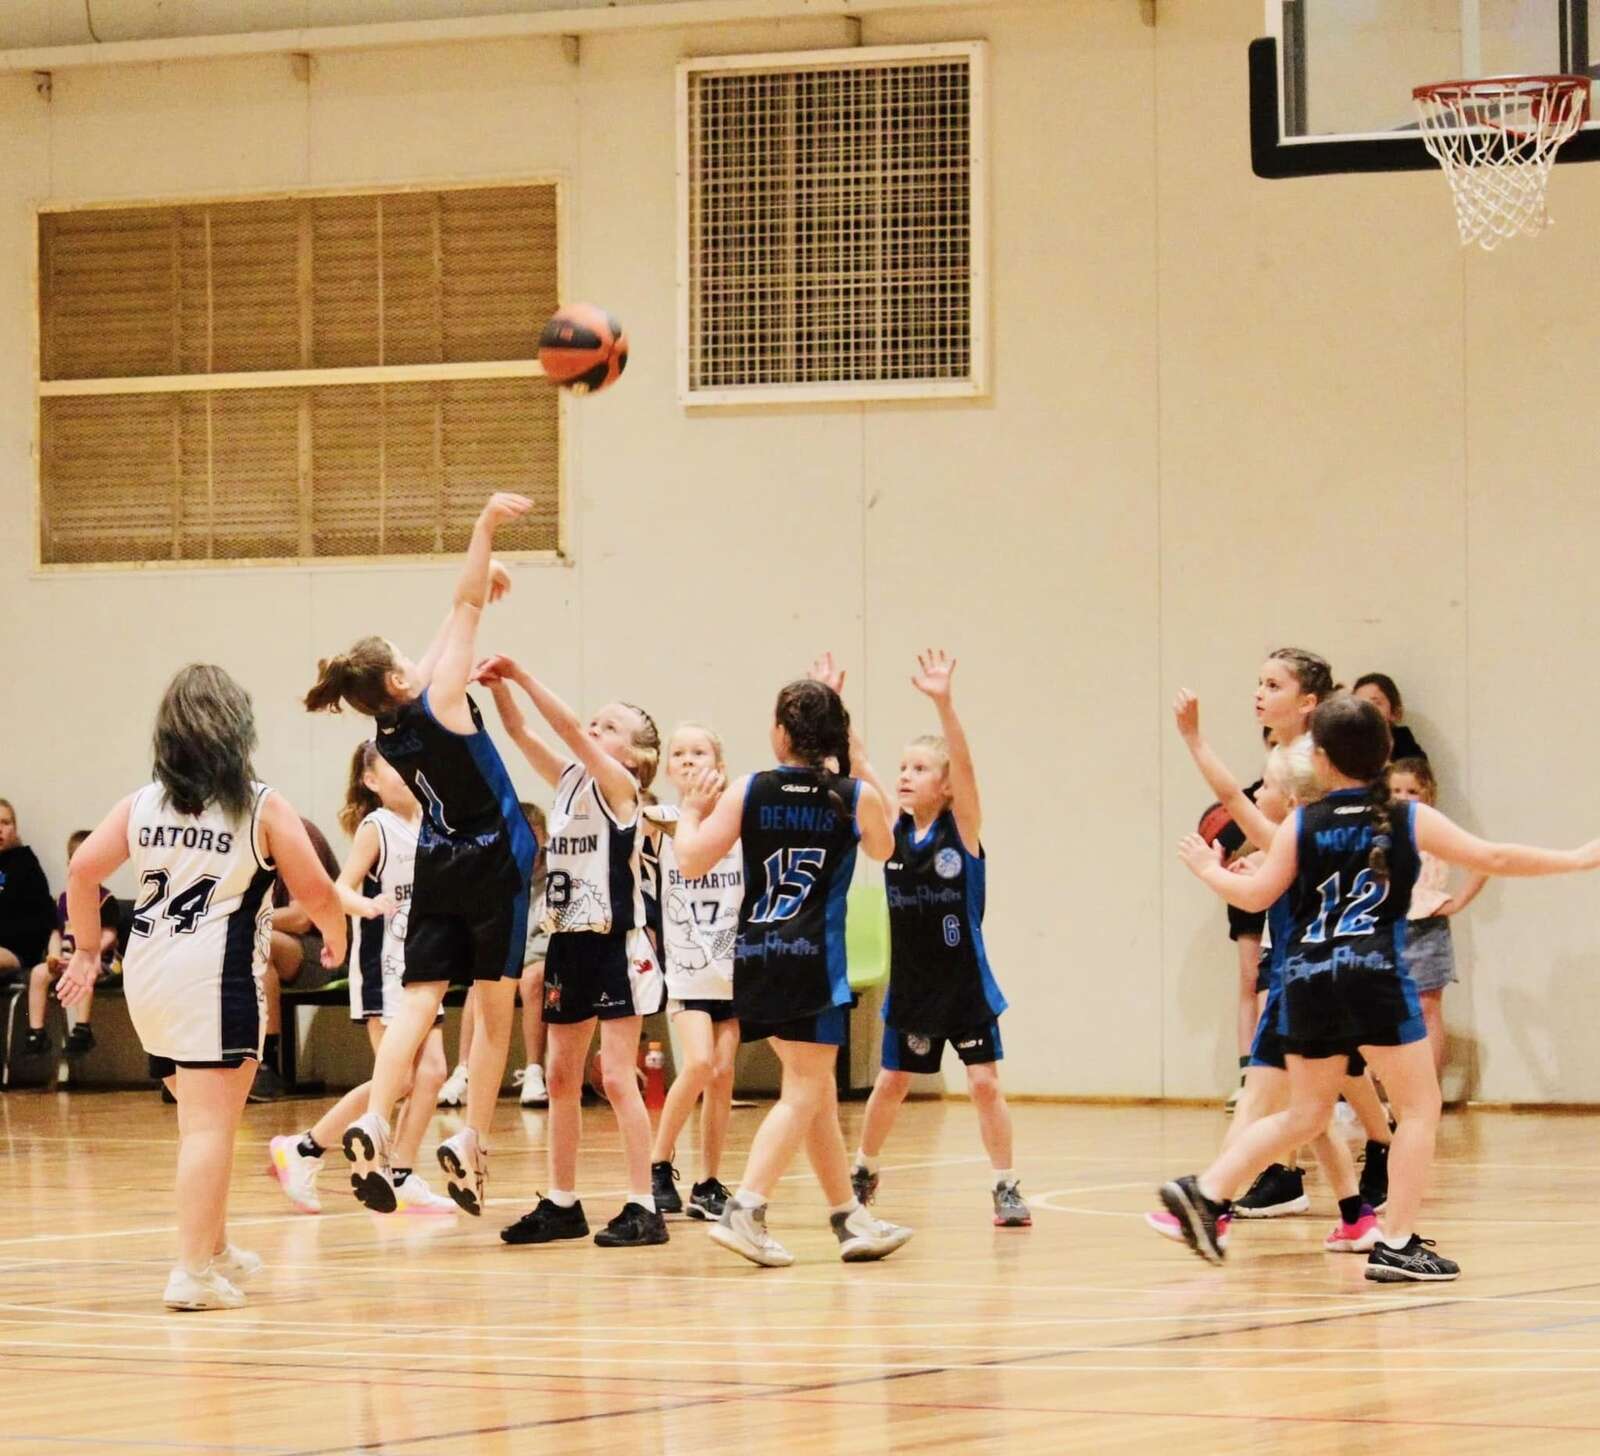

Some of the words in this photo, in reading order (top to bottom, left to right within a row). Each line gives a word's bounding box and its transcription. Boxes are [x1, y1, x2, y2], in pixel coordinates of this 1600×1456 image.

[760, 806, 837, 831] DENNIS
[138, 826, 234, 853] GATORS
[669, 870, 741, 889] SPPARTON
[748, 848, 826, 923] 15
[131, 867, 222, 938] 24
[691, 901, 719, 924] 17
[1301, 868, 1390, 943] 12
[943, 914, 960, 947] 6
